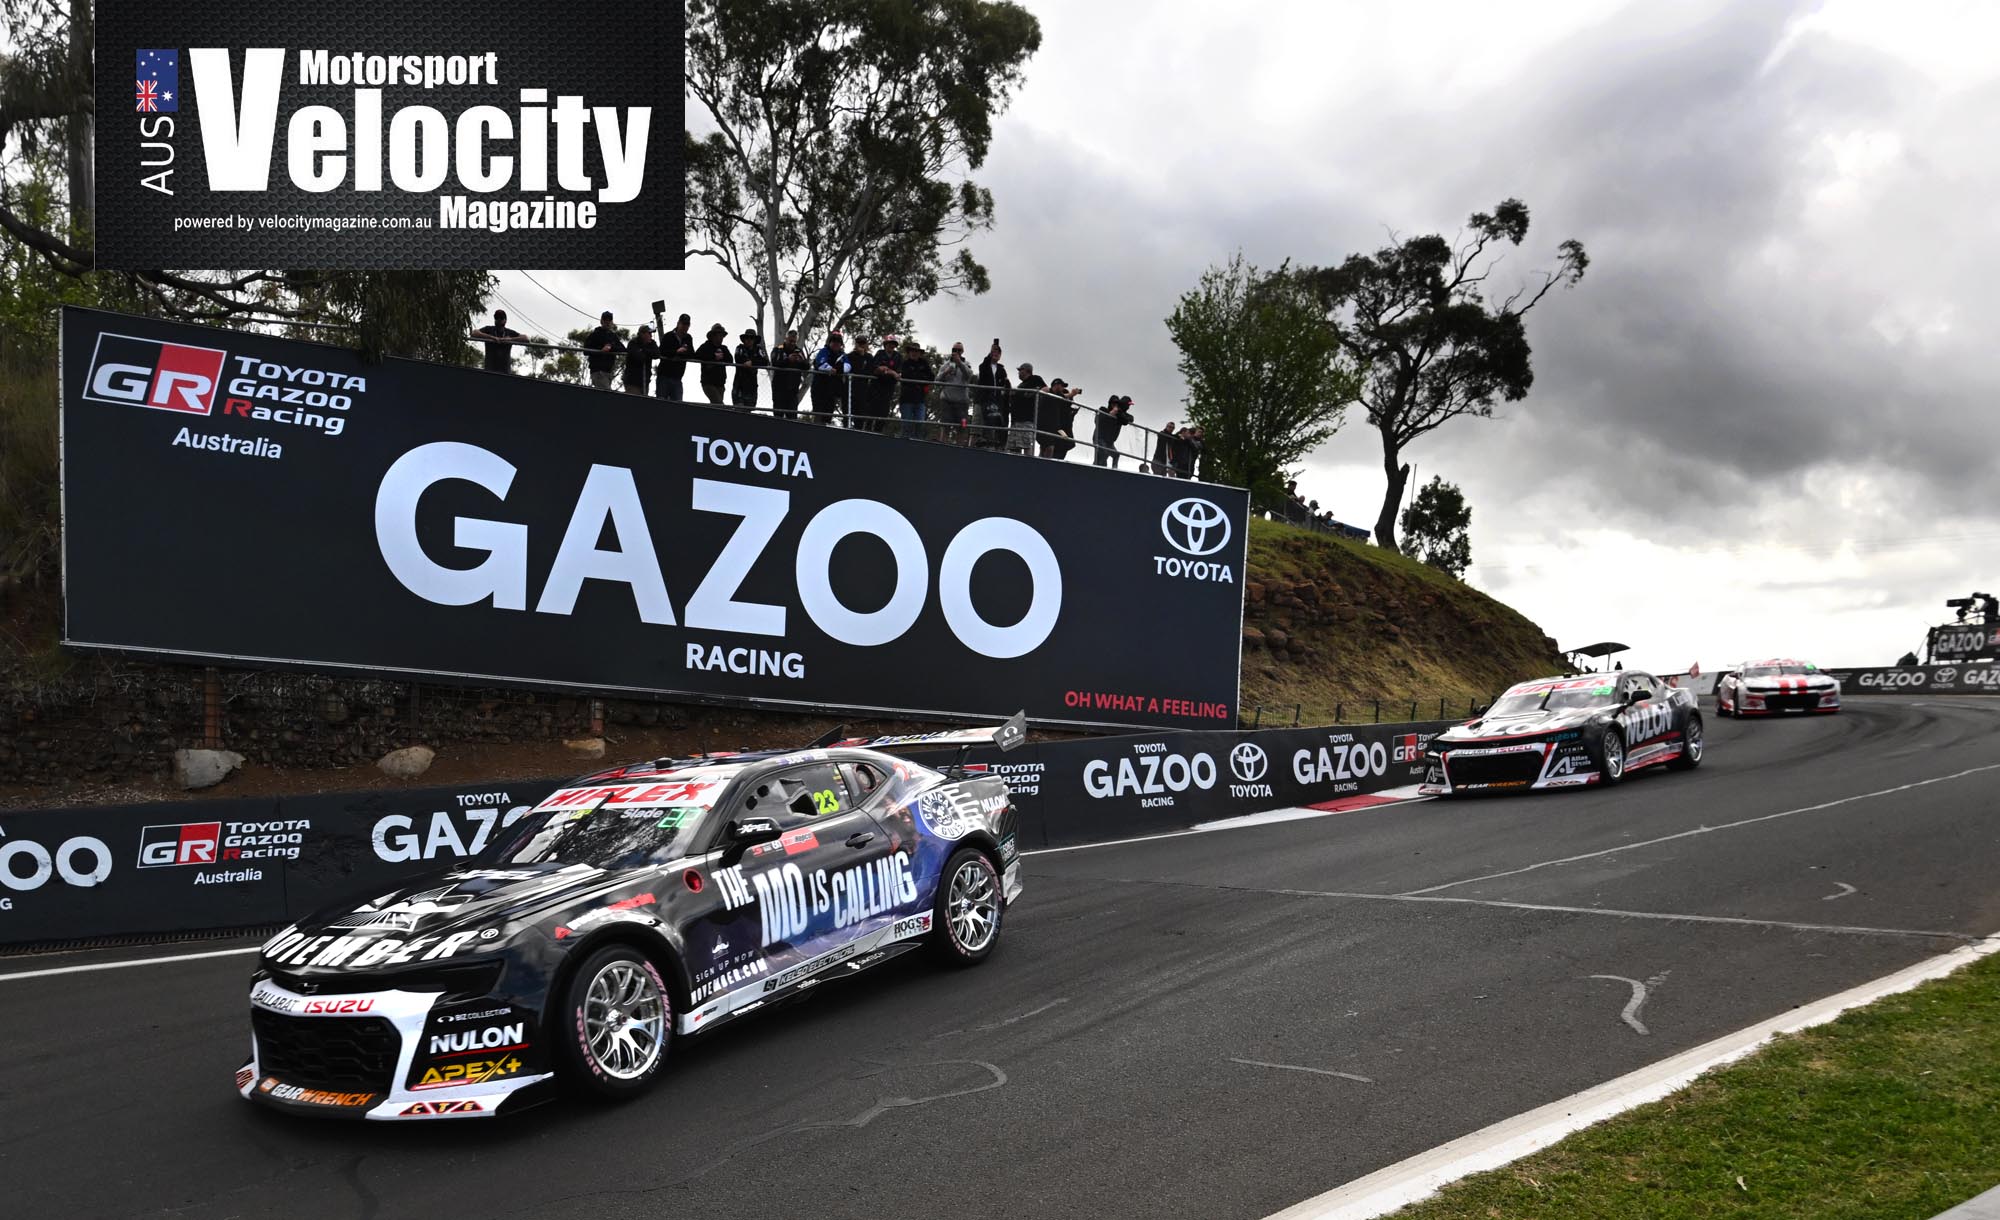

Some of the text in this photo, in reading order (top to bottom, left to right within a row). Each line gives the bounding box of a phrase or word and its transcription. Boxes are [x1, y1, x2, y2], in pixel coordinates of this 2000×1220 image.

[234, 355, 367, 392] TOYOTA
[92, 363, 212, 410] GR
[229, 378, 352, 411] GAZOO
[224, 398, 345, 436] Racing
[172, 427, 283, 459] Australia
[692, 435, 814, 479] TOYOTA
[375, 441, 1063, 659] GAZOO
[1154, 556, 1234, 584] TOYOTA
[1938, 631, 1985, 652] GAZOO
[686, 643, 805, 679] RACING
[1858, 672, 1926, 686] GAZOO
[1065, 690, 1228, 720] OH WHAT A FEELING
[1626, 700, 1673, 747] NULON
[1134, 743, 1167, 754] TOYOTA
[1329, 733, 1354, 743] TOYOTA
[1293, 742, 1386, 785] GAZOO
[1394, 745, 1416, 761] GR
[991, 763, 1045, 774] TOYOTA
[1003, 774, 1040, 783] AZOO
[1083, 752, 1217, 799] GAZOO
[539, 783, 718, 808] HIFLEX
[1009, 784, 1039, 796] cing
[1229, 784, 1273, 798] TOYOTA
[1334, 781, 1358, 792] RACING
[457, 792, 511, 807] TOYOTA
[813, 789, 840, 815] 23
[1142, 796, 1174, 808] RACING
[620, 808, 664, 819] Slade
[227, 819, 311, 835] TOYOTA
[372, 806, 533, 863] GAZ
[737, 823, 772, 834] XPEL
[143, 837, 215, 865] GR
[224, 833, 302, 848] GAZOO
[223, 844, 300, 862] Racing
[194, 868, 262, 885] Australia
[711, 864, 754, 911] THE
[753, 862, 808, 948] MO
[808, 871, 828, 917] IS
[831, 851, 919, 930] CALLING
[894, 917, 922, 935] HOG'S
[696, 950, 755, 983] SIGN UP NOW
[304, 999, 375, 1014] ISUZU
[430, 1022, 525, 1054] NULON
[270, 1083, 377, 1106] GEARWRENCH
